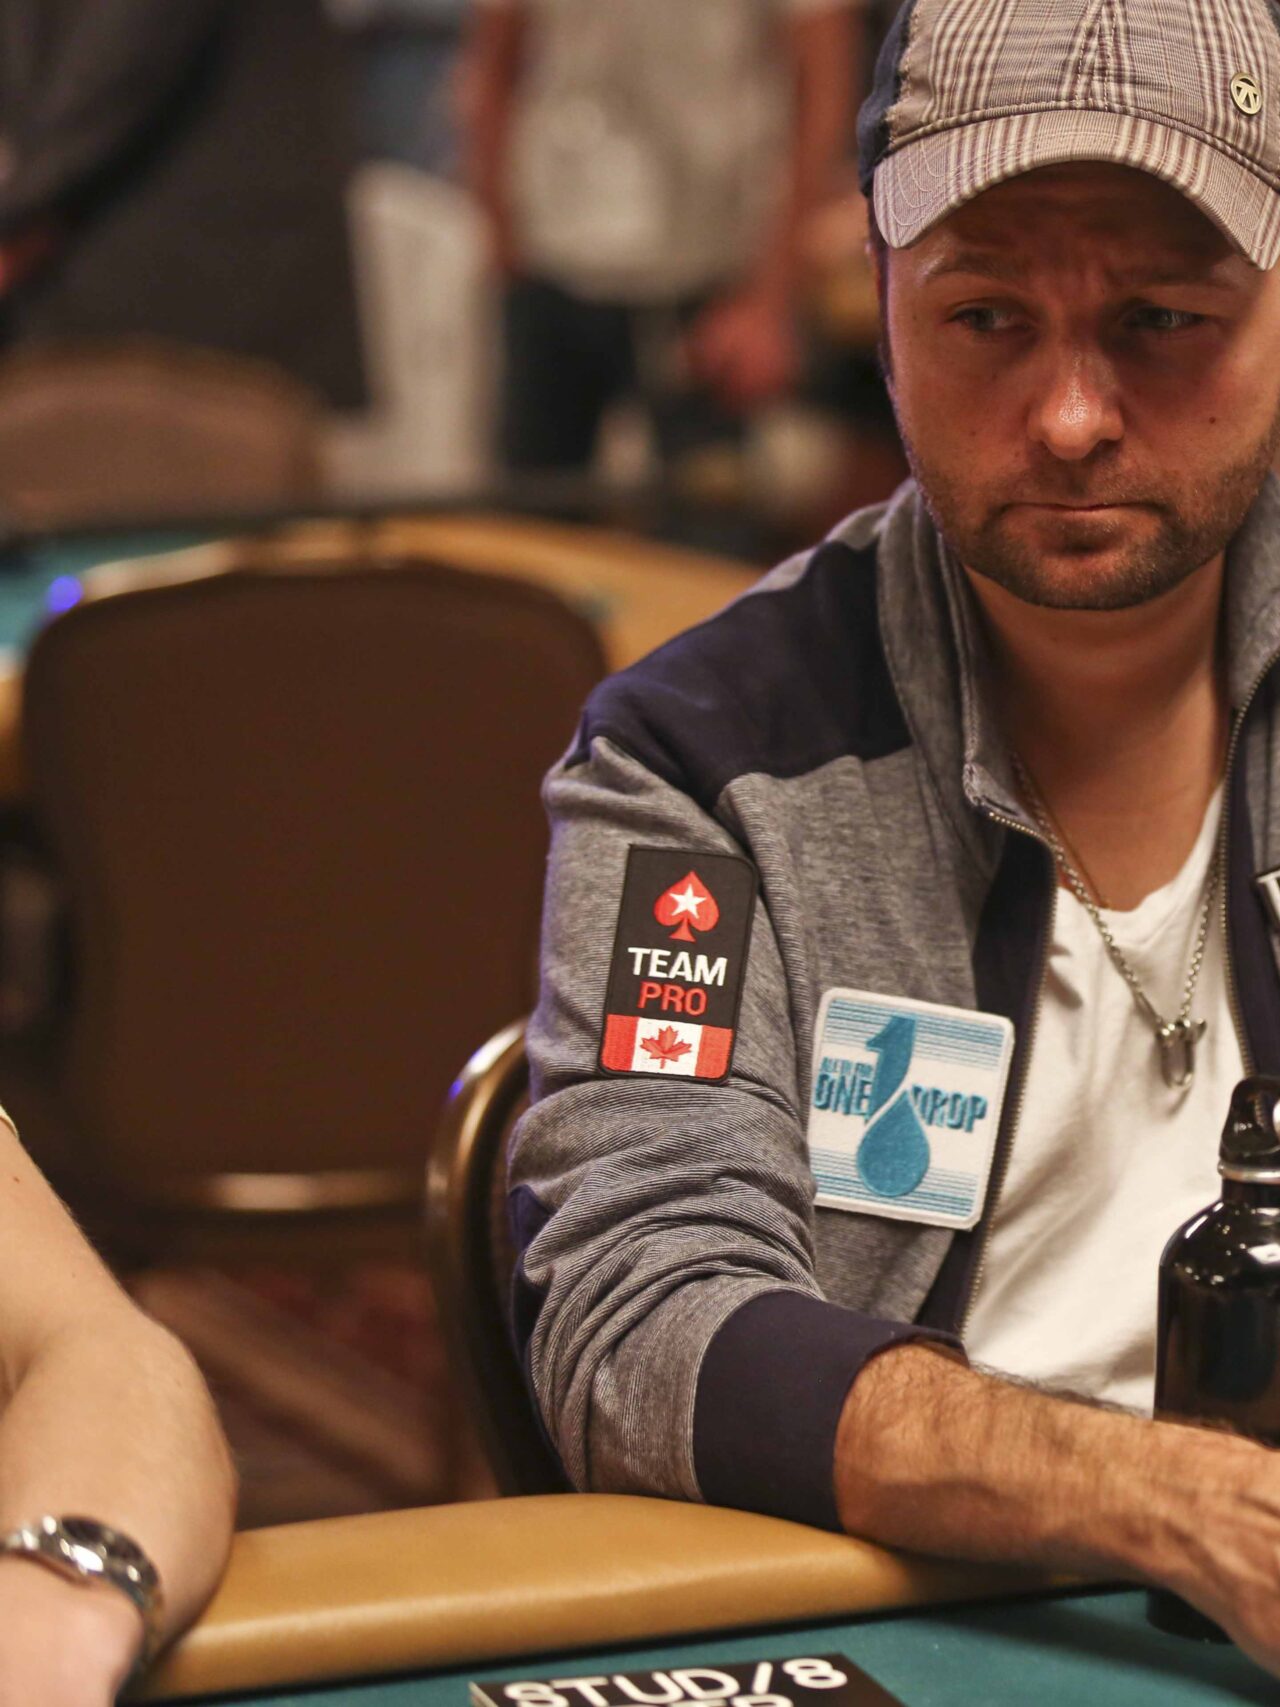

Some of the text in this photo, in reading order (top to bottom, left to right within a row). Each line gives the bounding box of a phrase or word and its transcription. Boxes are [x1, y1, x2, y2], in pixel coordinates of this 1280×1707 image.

[627, 947, 728, 987] TEAM
[637, 981, 707, 1016] PRO
[814, 1073, 988, 1133] ONE DROP
